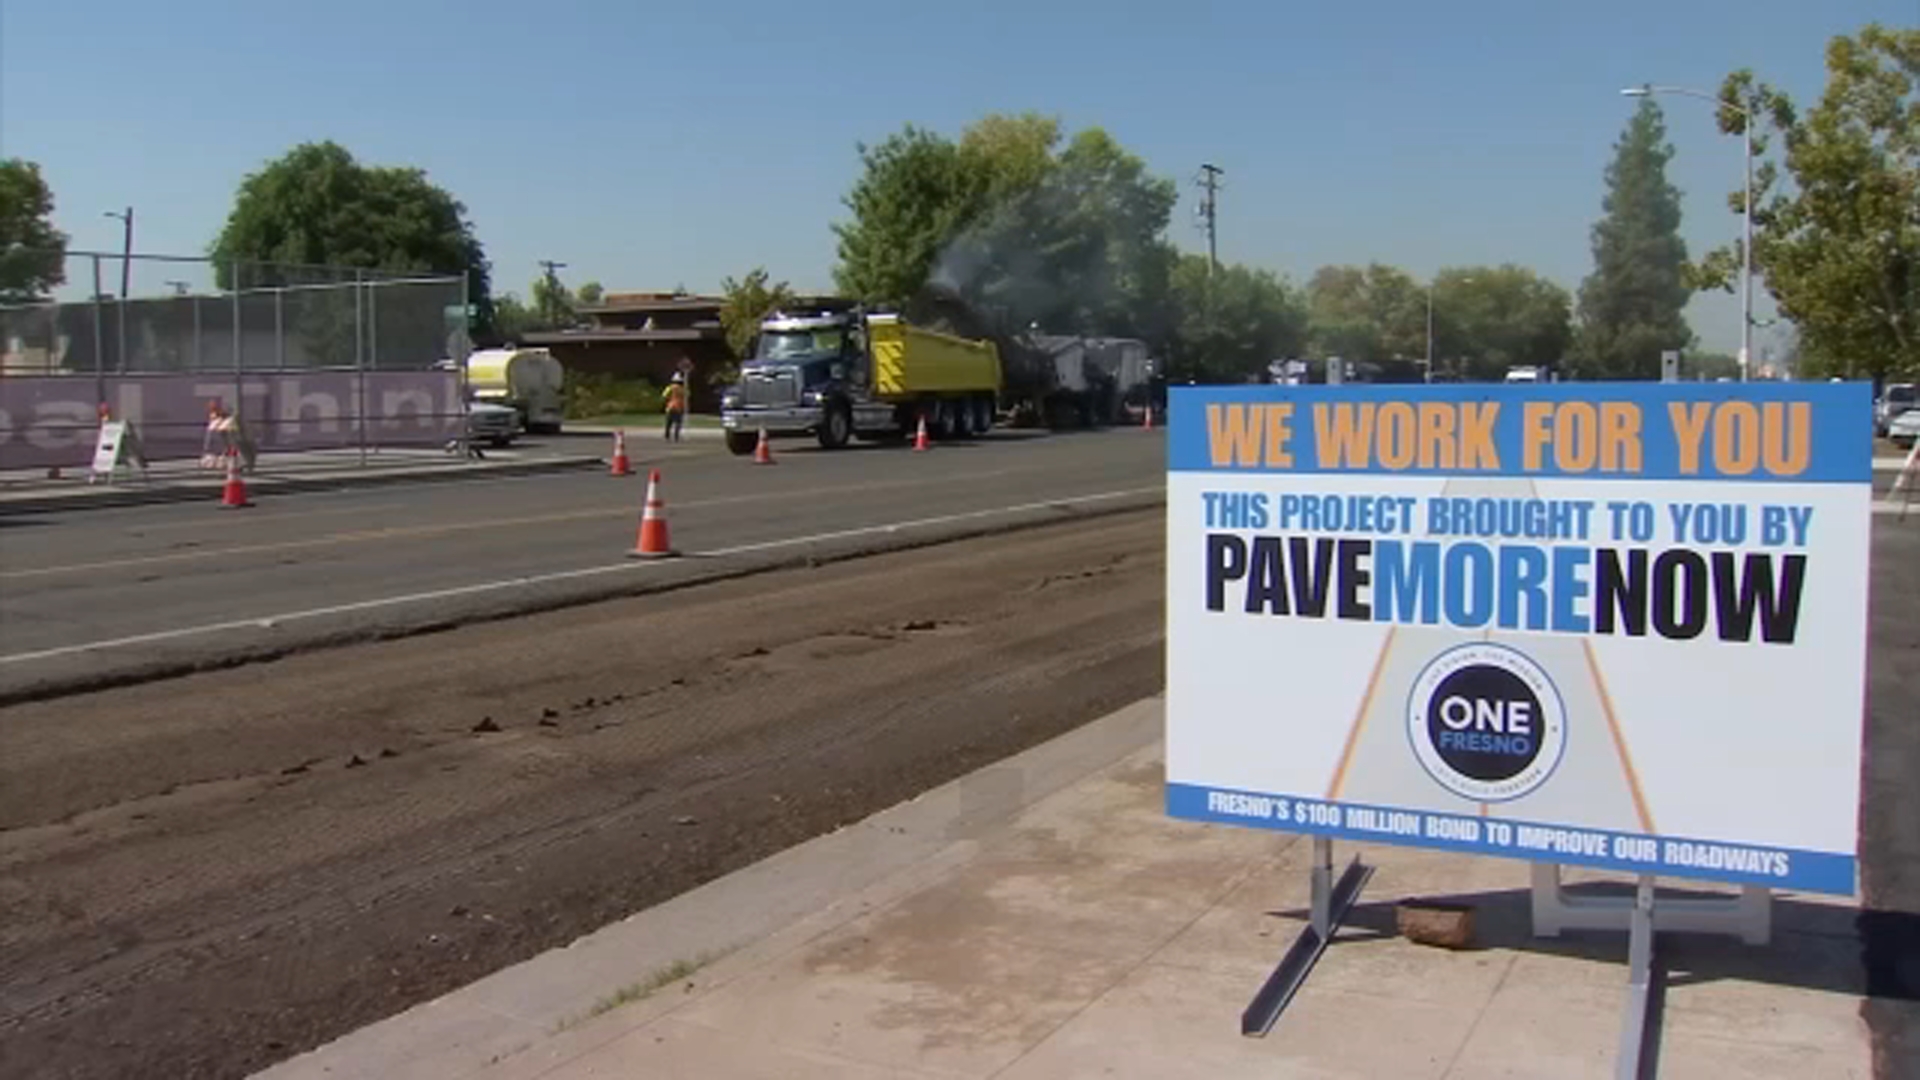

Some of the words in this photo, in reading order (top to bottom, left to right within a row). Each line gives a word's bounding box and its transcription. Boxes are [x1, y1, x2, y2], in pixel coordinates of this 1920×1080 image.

[0, 384, 142, 450] al
[1206, 404, 1294, 467] WE
[1312, 402, 1502, 470] WORK
[1523, 402, 1643, 473] FOR
[1669, 402, 1812, 476] YOU
[1202, 492, 1269, 529] THIS
[1280, 495, 1417, 535] PROJECT
[1427, 498, 1594, 541] BROUGHT
[1607, 502, 1654, 542] TO
[1669, 504, 1747, 546] YOU
[1762, 506, 1813, 547] BY
[1439, 731, 1530, 755] FRESNO
[1440, 696, 1530, 733] ONE
[1208, 791, 1290, 820] FRESNO'S
[1295, 798, 1341, 827] $100
[1346, 807, 1421, 836] MILLION
[1426, 815, 1480, 842] BOND
[1485, 821, 1512, 845] TO
[1517, 824, 1608, 857] IMPROVE
[1614, 836, 1658, 862] OUR
[1664, 841, 1790, 877] ROADWAYS
